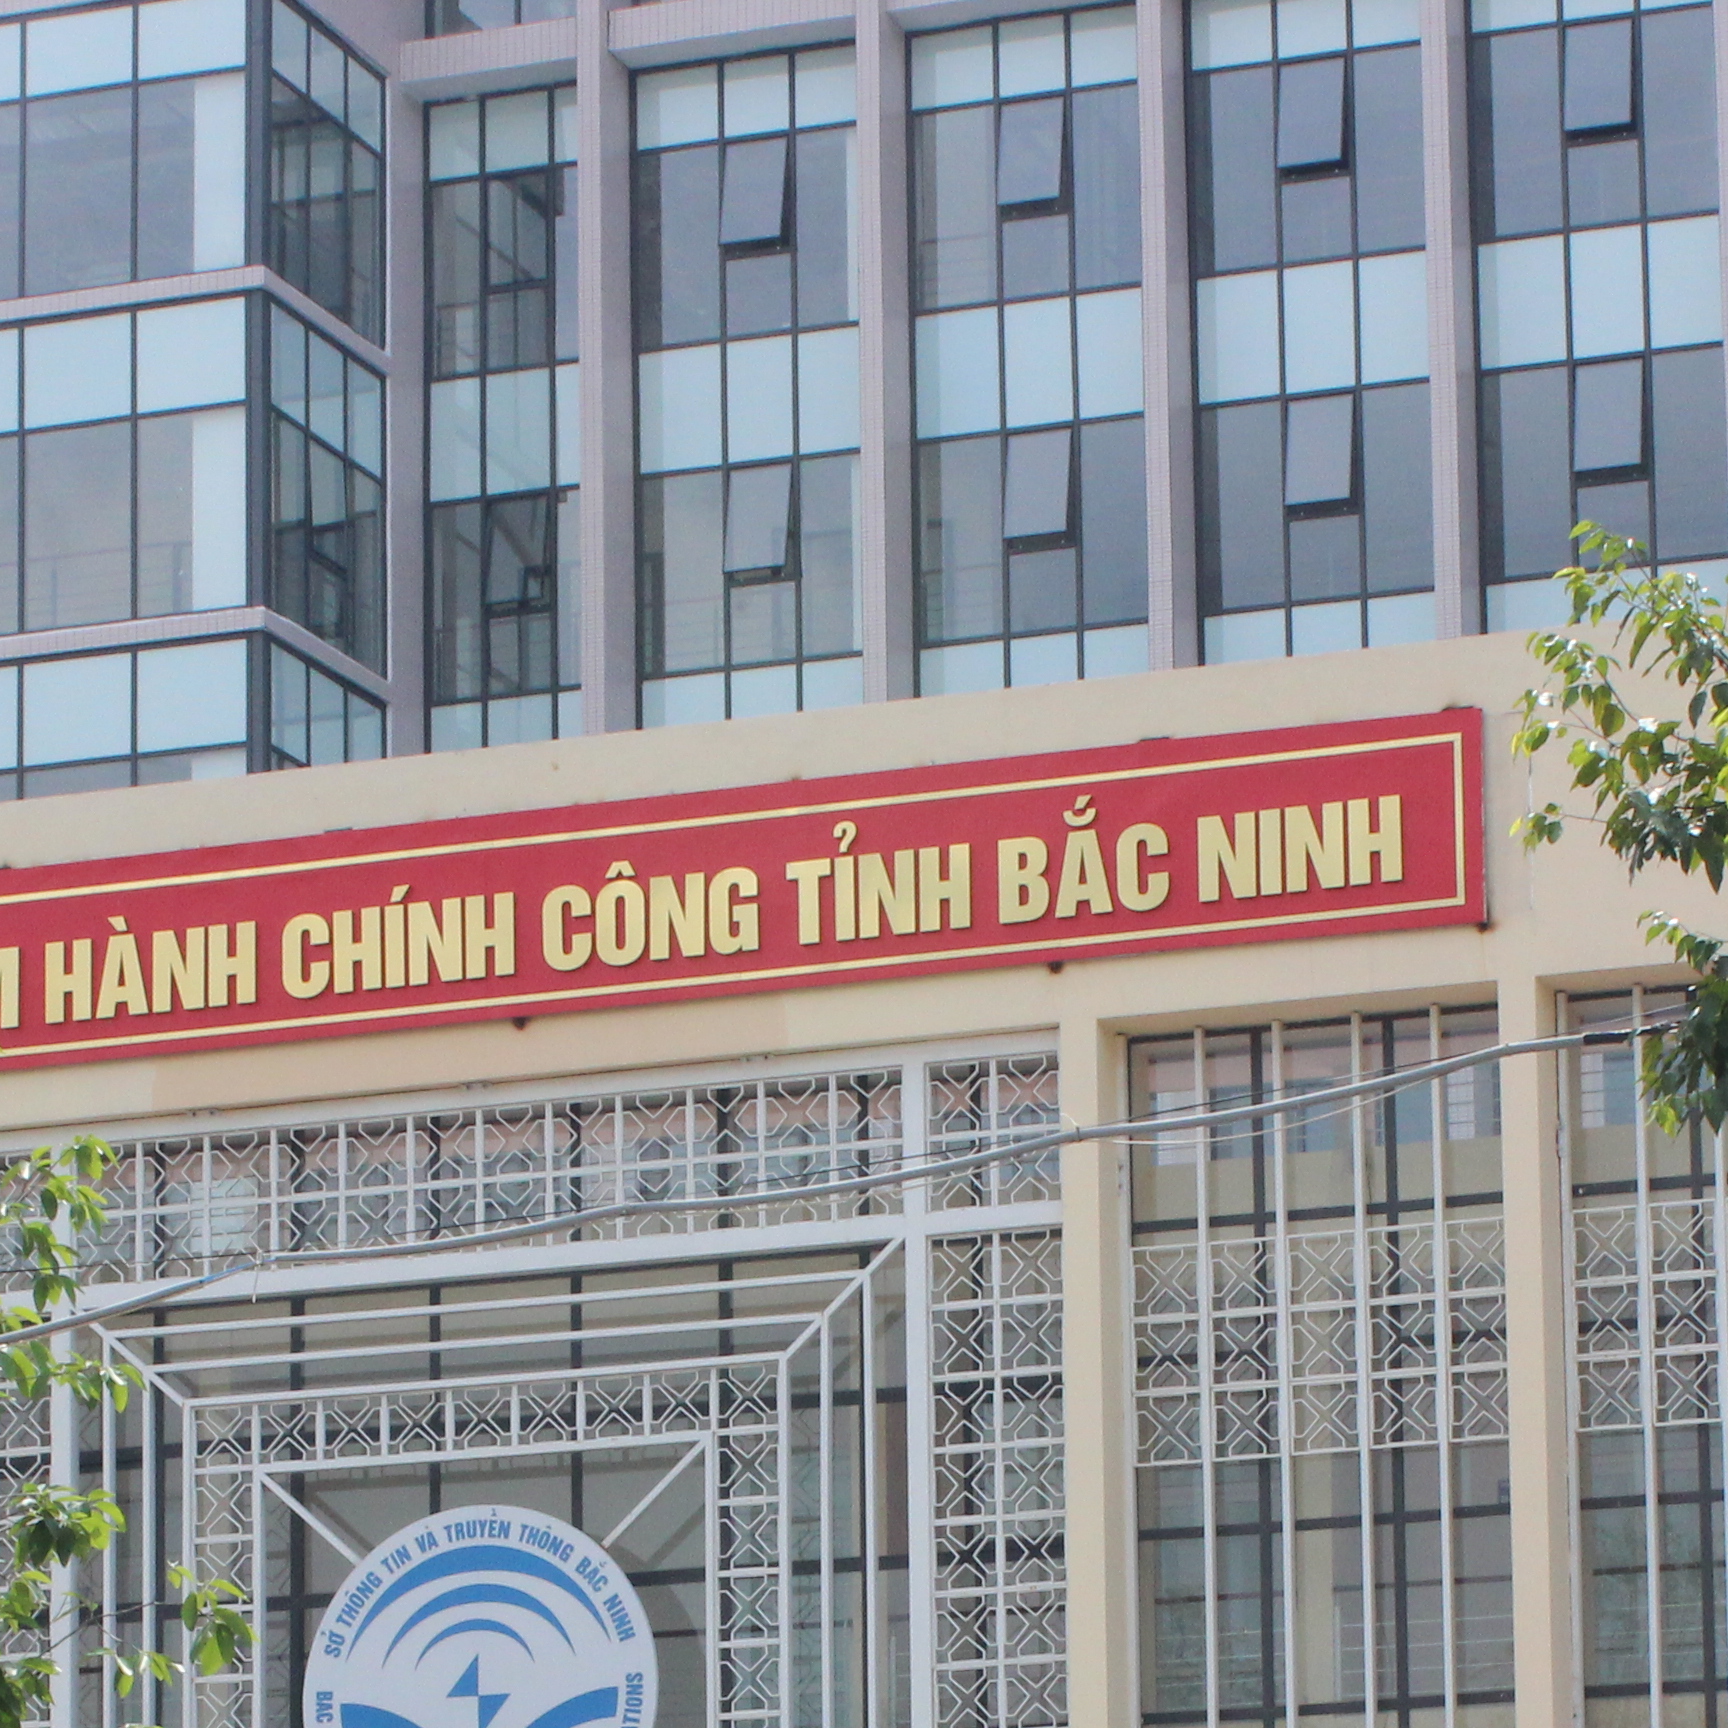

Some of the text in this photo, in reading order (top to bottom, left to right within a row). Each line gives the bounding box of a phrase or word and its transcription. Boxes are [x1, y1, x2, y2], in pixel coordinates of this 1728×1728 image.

[44, 916, 257, 1025] HÀNH
[281, 885, 514, 999] CHÍNH
[541, 861, 758, 972] CÔNG
[786, 821, 971, 945] TỈNH
[997, 794, 1169, 925] BẮC
[1197, 794, 1403, 903] NINH
[336, 1571, 382, 1627] THÔNG
[380, 1544, 413, 1574] TIN
[518, 1525, 574, 1563] THÔNG
[574, 1556, 609, 1592] BẮC
[603, 1592, 636, 1642] NINH
[316, 1691, 333, 1723] BAC
